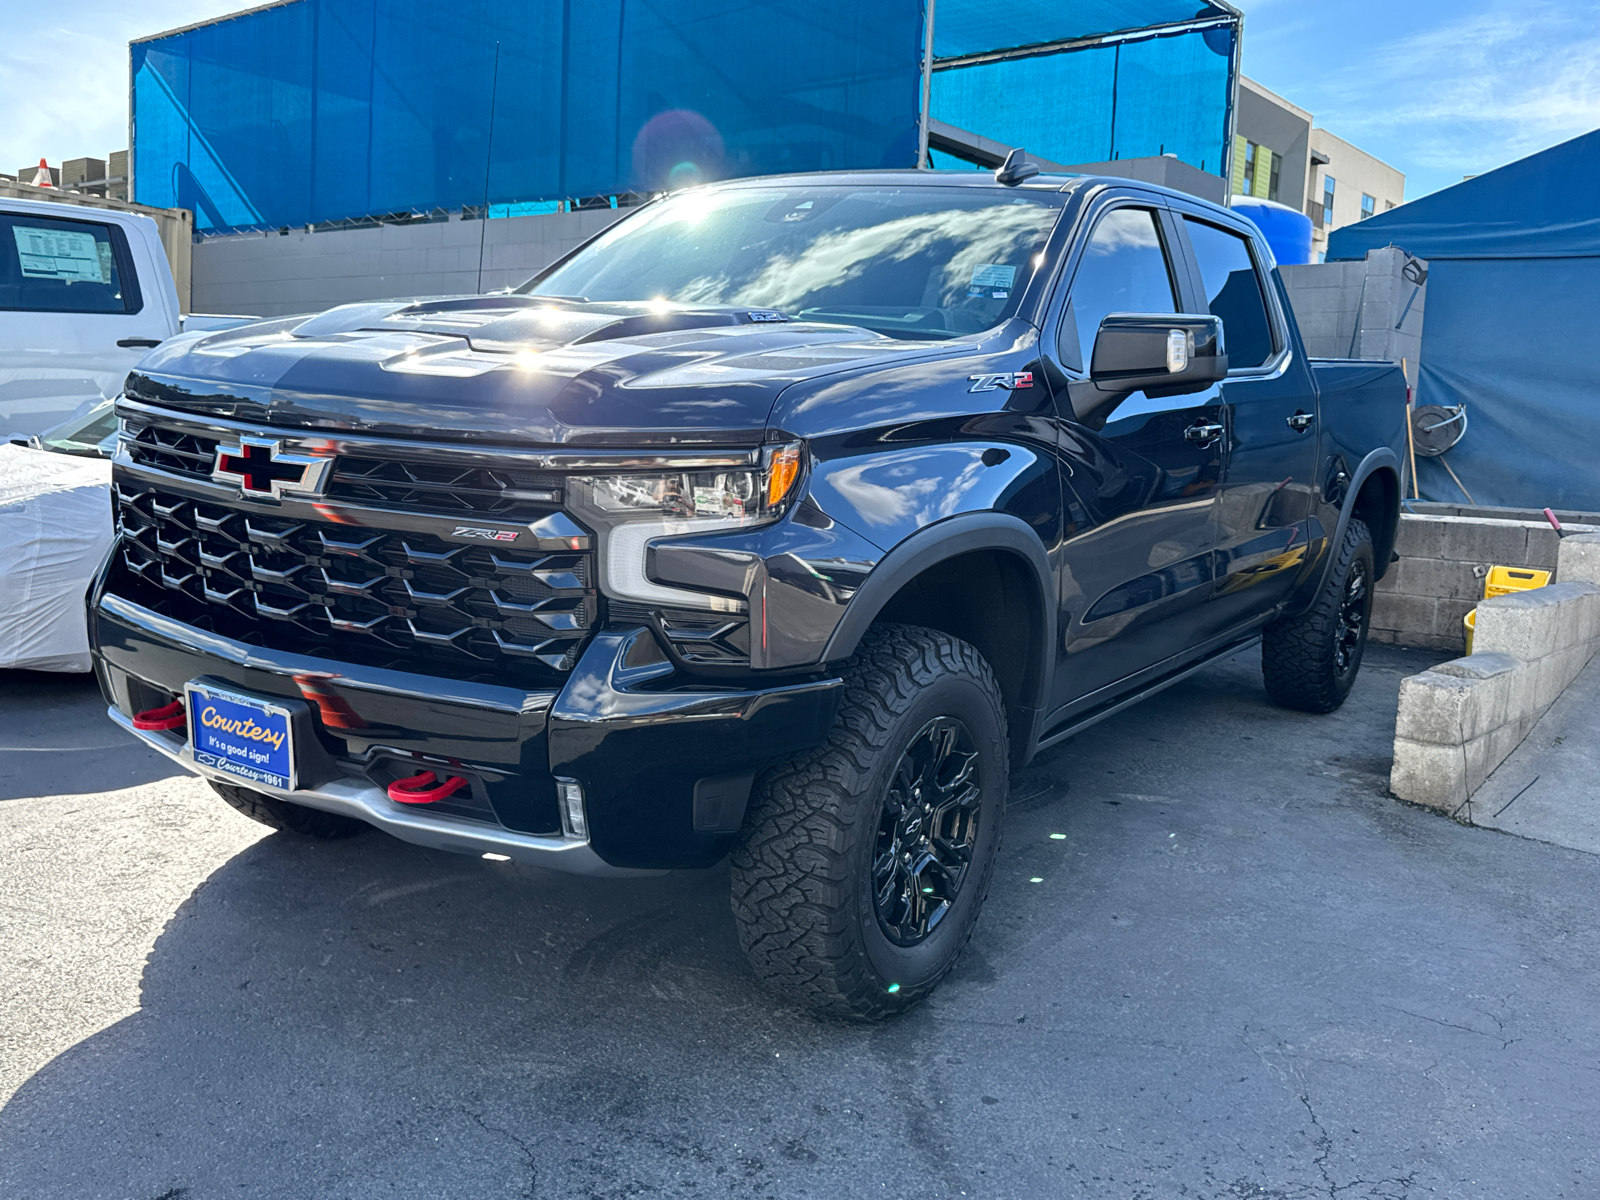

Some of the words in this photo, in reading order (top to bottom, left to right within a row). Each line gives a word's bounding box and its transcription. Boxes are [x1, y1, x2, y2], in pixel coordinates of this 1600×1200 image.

[967, 371, 1034, 393] ZR2
[451, 525, 521, 542] ZR2
[201, 706, 286, 751] Courtesy
[209, 735, 220, 748] It's
[226, 744, 248, 758] good
[248, 749, 270, 764] sign!
[217, 757, 259, 781] Courtesy
[263, 773, 283, 787] 1961
